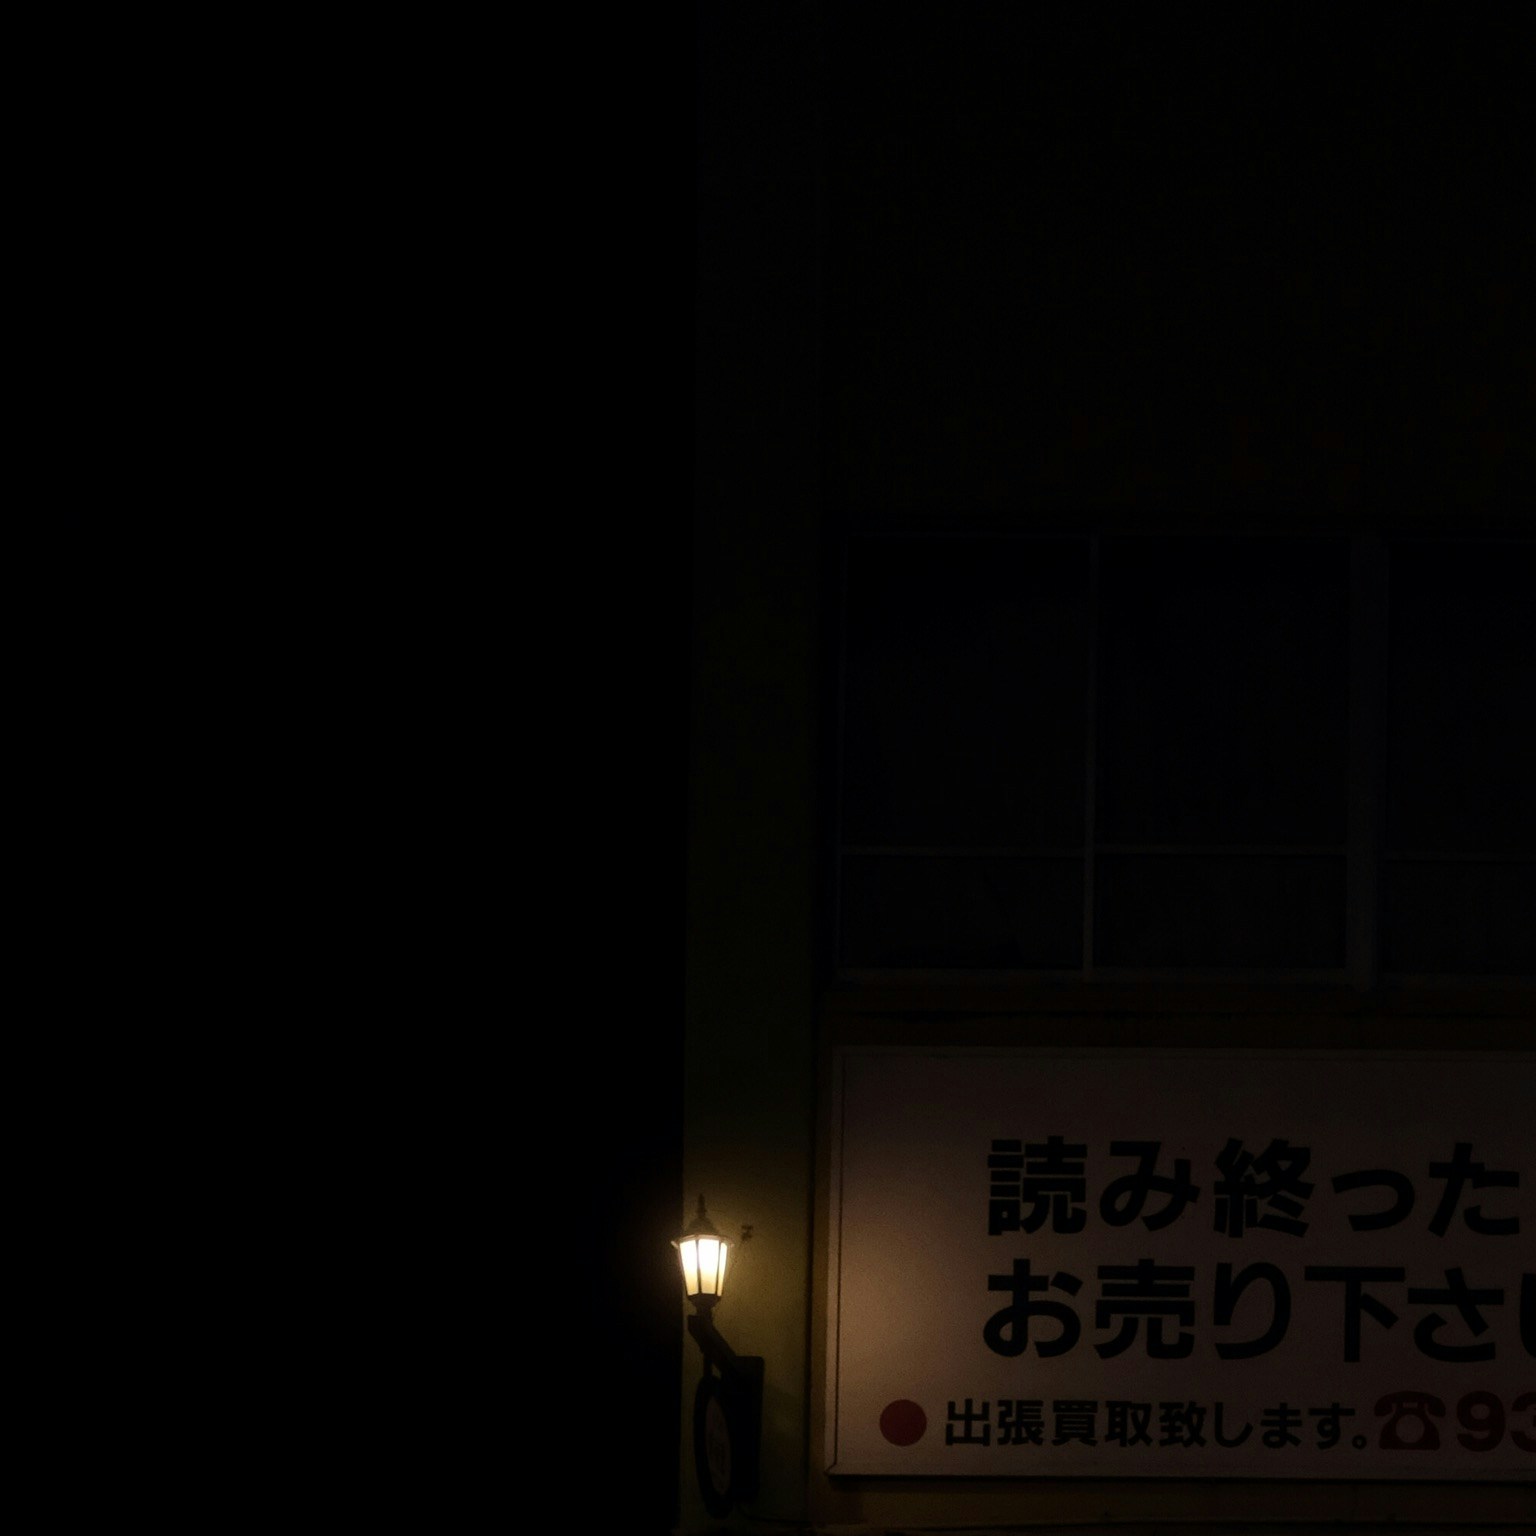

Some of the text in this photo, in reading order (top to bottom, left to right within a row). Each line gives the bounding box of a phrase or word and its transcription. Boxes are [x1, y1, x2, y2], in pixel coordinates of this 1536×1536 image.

[945, 1400, 1369, 1449] 出張買取致します。
